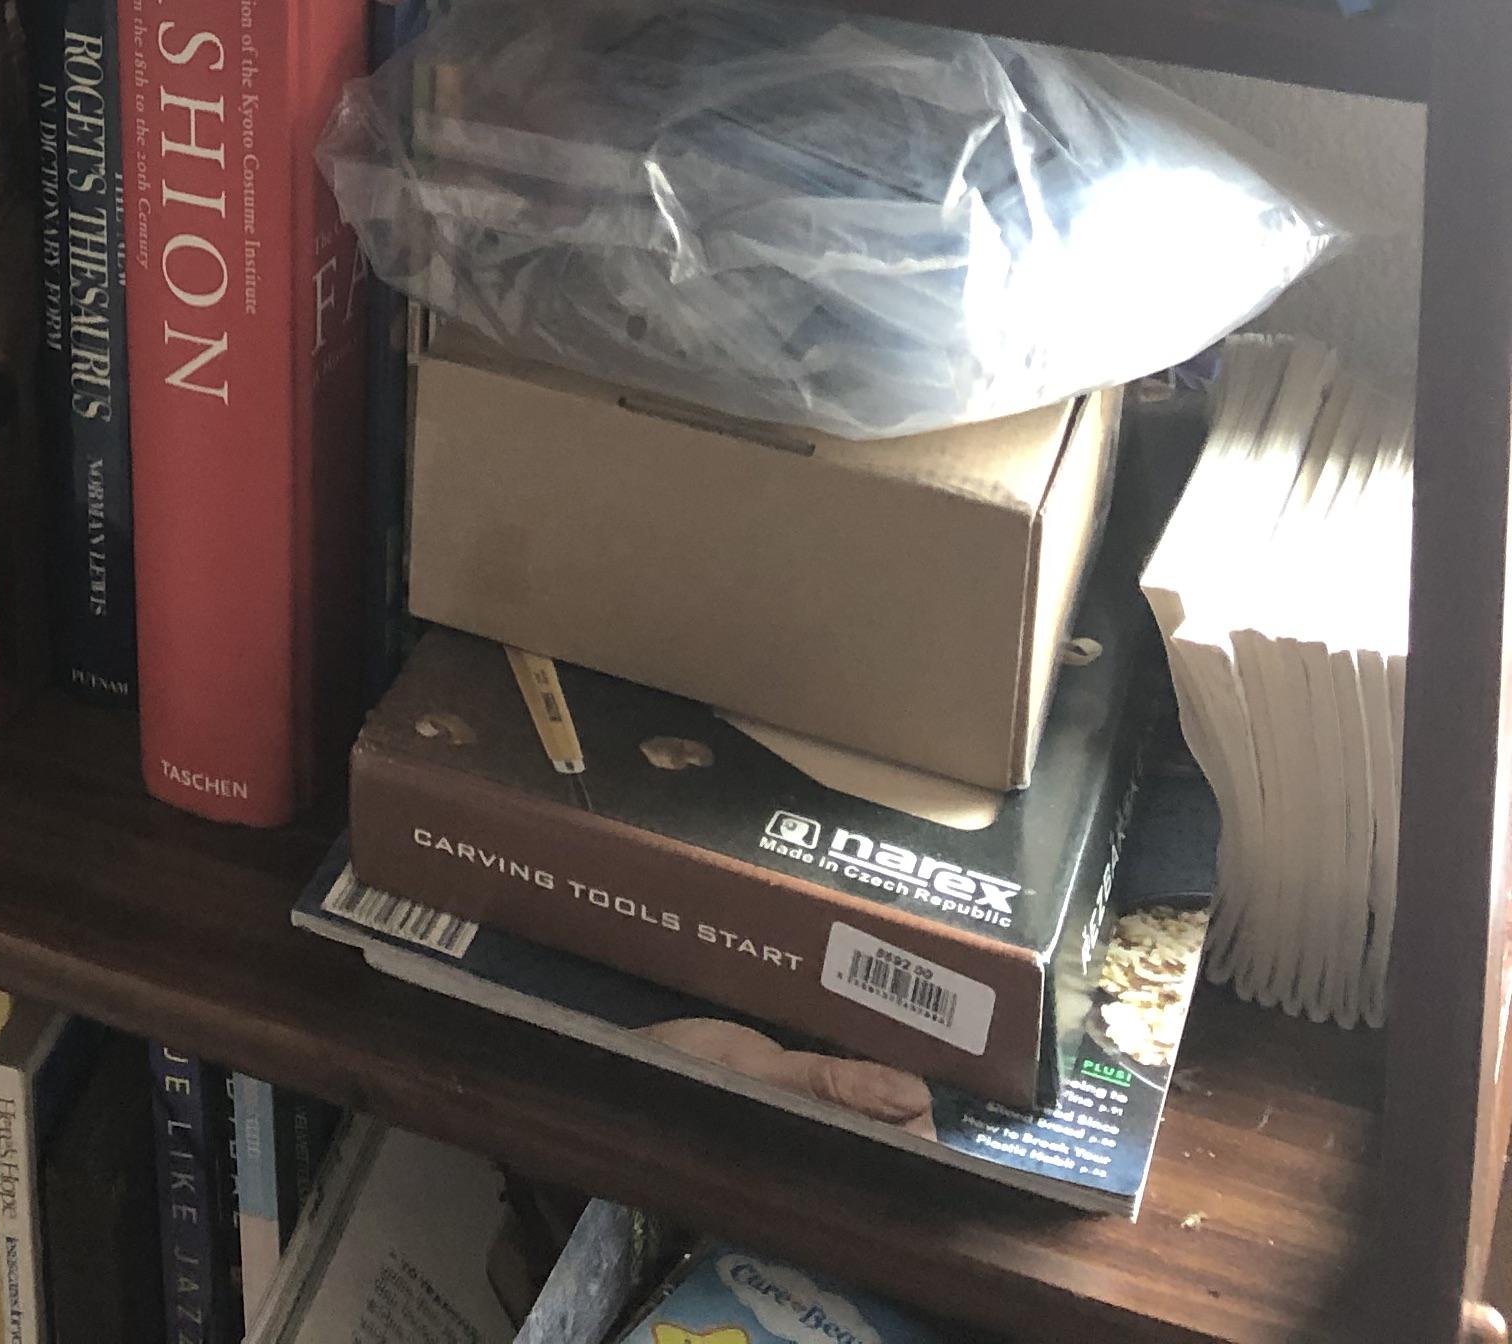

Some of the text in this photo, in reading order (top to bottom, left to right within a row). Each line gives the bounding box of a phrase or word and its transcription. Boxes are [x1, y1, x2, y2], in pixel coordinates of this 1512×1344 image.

[134, 17, 148, 48] the
[240, 32, 259, 53] of
[134, 51, 150, 92] 18th
[240, 55, 260, 90] the
[136, 117, 151, 146] the
[240, 92, 259, 149] Kyoto
[136, 150, 152, 192] 20th
[242, 153, 261, 235] Costume
[37, 82, 64, 353] IN DICTIONARY FORM
[63, 27, 114, 422] ROGET'S THESAURUS
[135, 198, 152, 271] Century
[243, 239, 262, 315] Institute
[86, 458, 106, 546] NORMAN
[71, 667, 129, 696] PUTNAM
[160, 758, 249, 800] TASCHEN
[413, 826, 805, 976] CARVING TOOLS START
[758, 835, 1013, 930] Made in Czech Republic
[829, 825, 1031, 914] narex
[166, 1117, 197, 1227] LIKE
